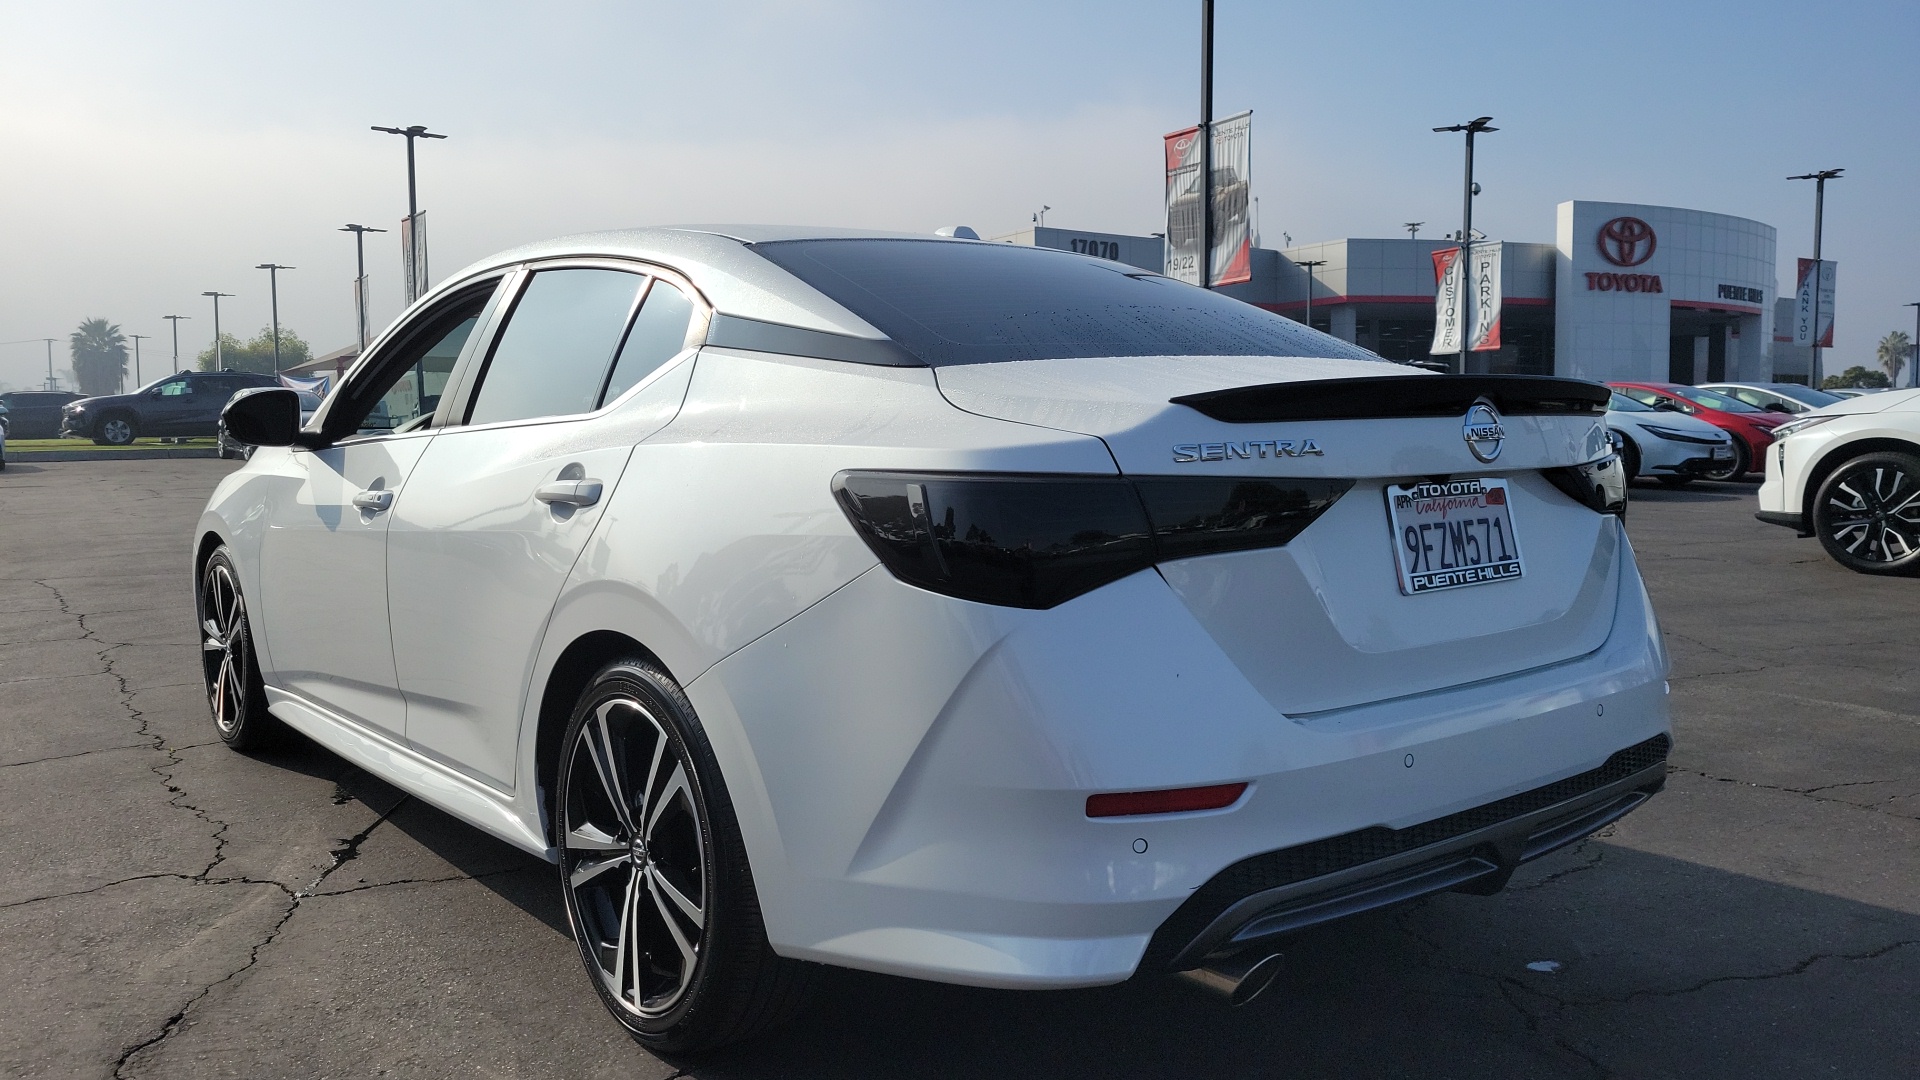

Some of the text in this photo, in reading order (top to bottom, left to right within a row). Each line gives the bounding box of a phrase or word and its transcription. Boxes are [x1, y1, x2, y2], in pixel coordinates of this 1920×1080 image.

[1070, 239, 1119, 260] 17070
[1584, 272, 1663, 294] TOYOTA
[1442, 266, 1455, 347] CUSTOMER
[1479, 261, 1491, 344] PARKING
[1800, 317, 1808, 340] YOU
[1471, 426, 1505, 437] NISSAN
[1172, 438, 1325, 463] SENTRA
[1419, 482, 1480, 497] TOYOTA
[1397, 495, 1413, 510] APR
[1416, 497, 1488, 519] California
[1405, 517, 1513, 573] 9FZM571
[1413, 564, 1521, 590] PUENTE HILLS
